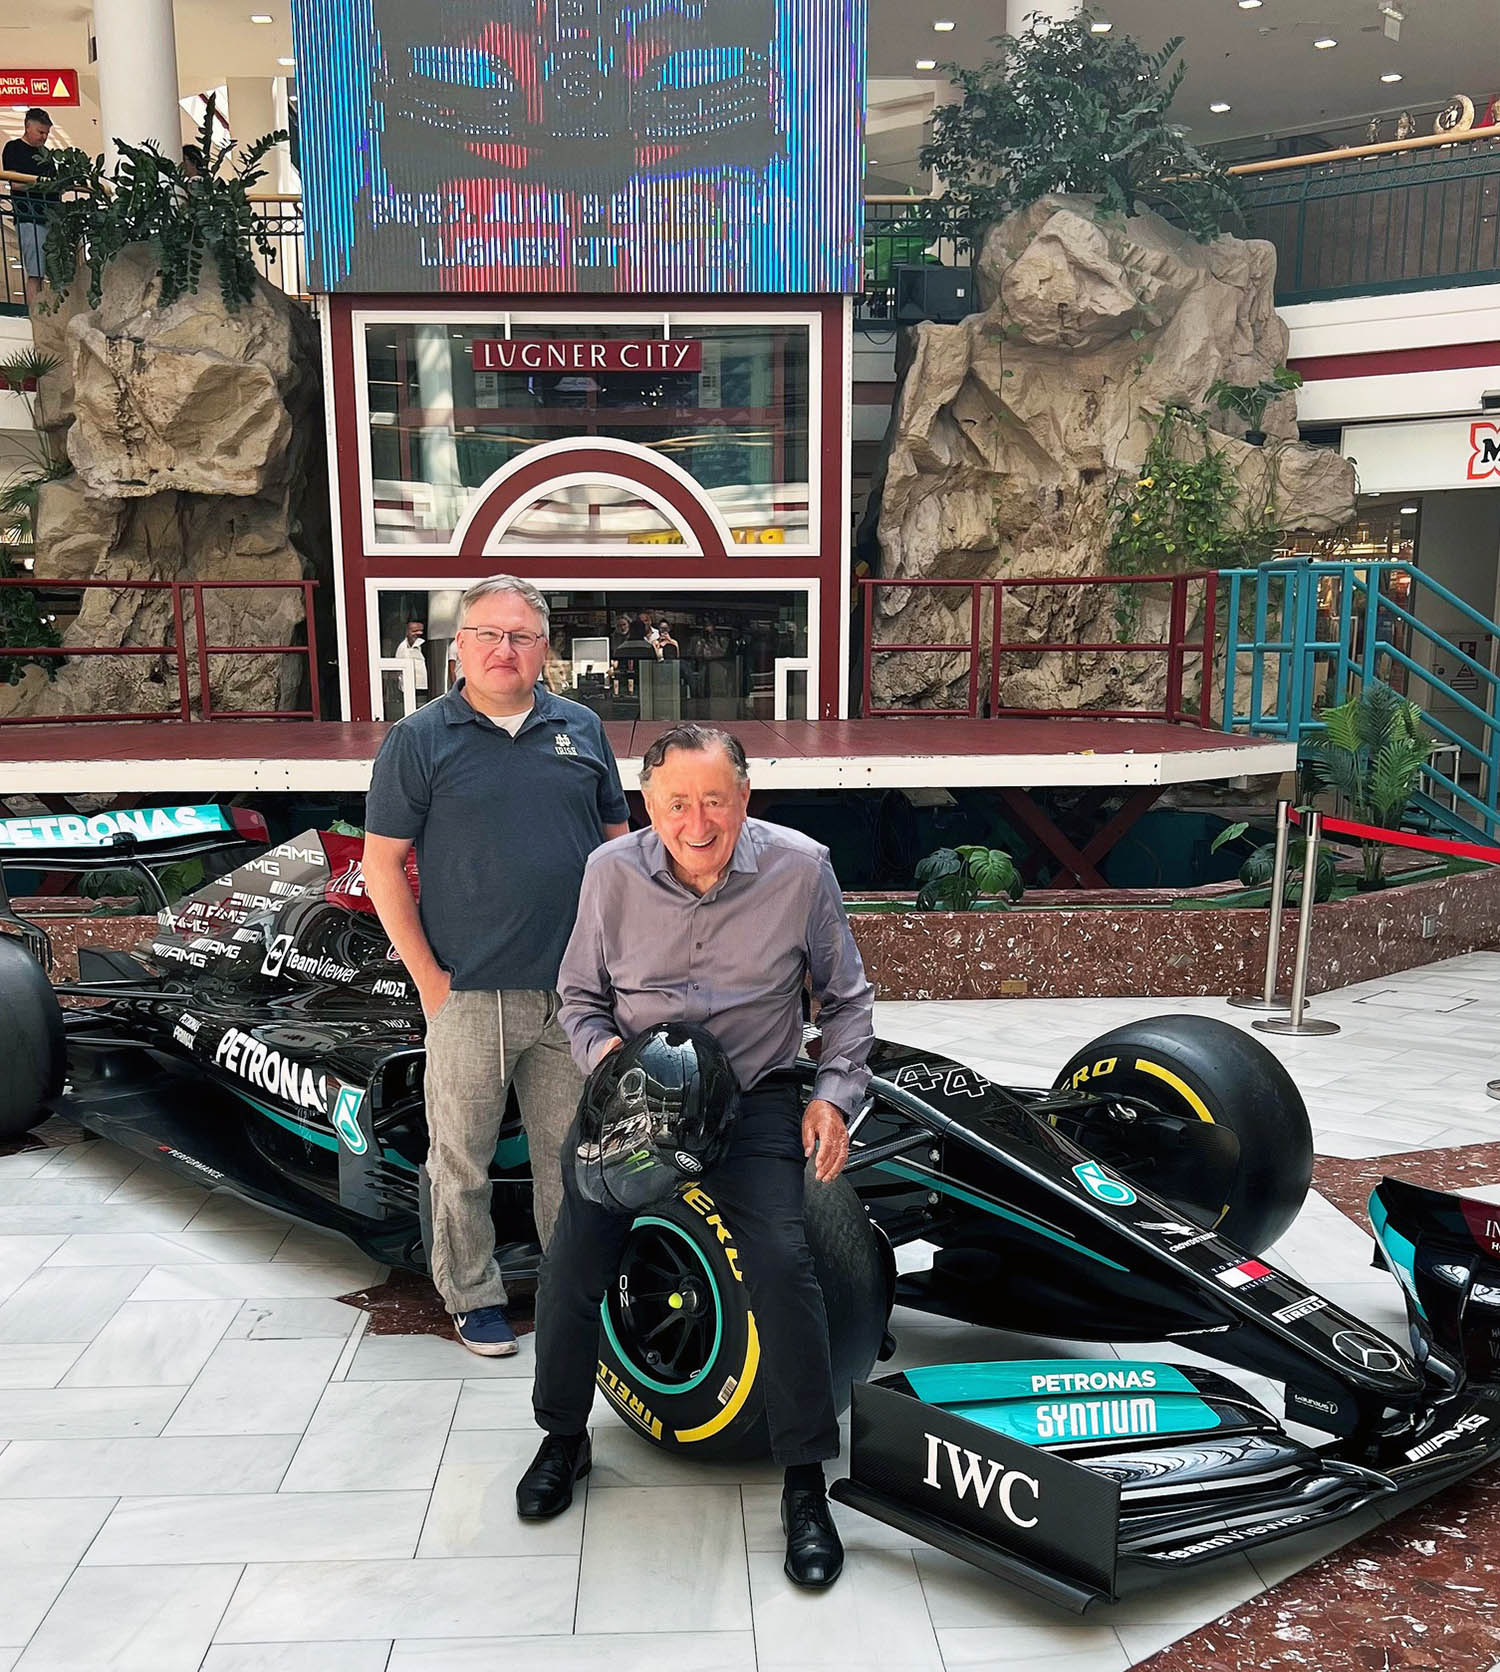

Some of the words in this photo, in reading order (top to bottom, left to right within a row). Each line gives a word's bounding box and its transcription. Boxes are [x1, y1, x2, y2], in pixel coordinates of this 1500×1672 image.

[0, 77, 25, 86] INDER
[0, 86, 28, 95] ARTEN
[33, 82, 48, 91] WC
[484, 344, 607, 368] LUGNER
[619, 344, 690, 368] CITY
[274, 844, 325, 867] AMG
[286, 947, 360, 983] TeamViewer
[371, 979, 397, 996] AMD
[895, 1063, 992, 1098] 44
[1271, 1294, 1329, 1325] PIRELLI
[1031, 1370, 1157, 1393] PETRONAS
[595, 1359, 664, 1441] PIRELL
[922, 1432, 1041, 1529] IWC
[1148, 1513, 1311, 1561] TeamViewer
